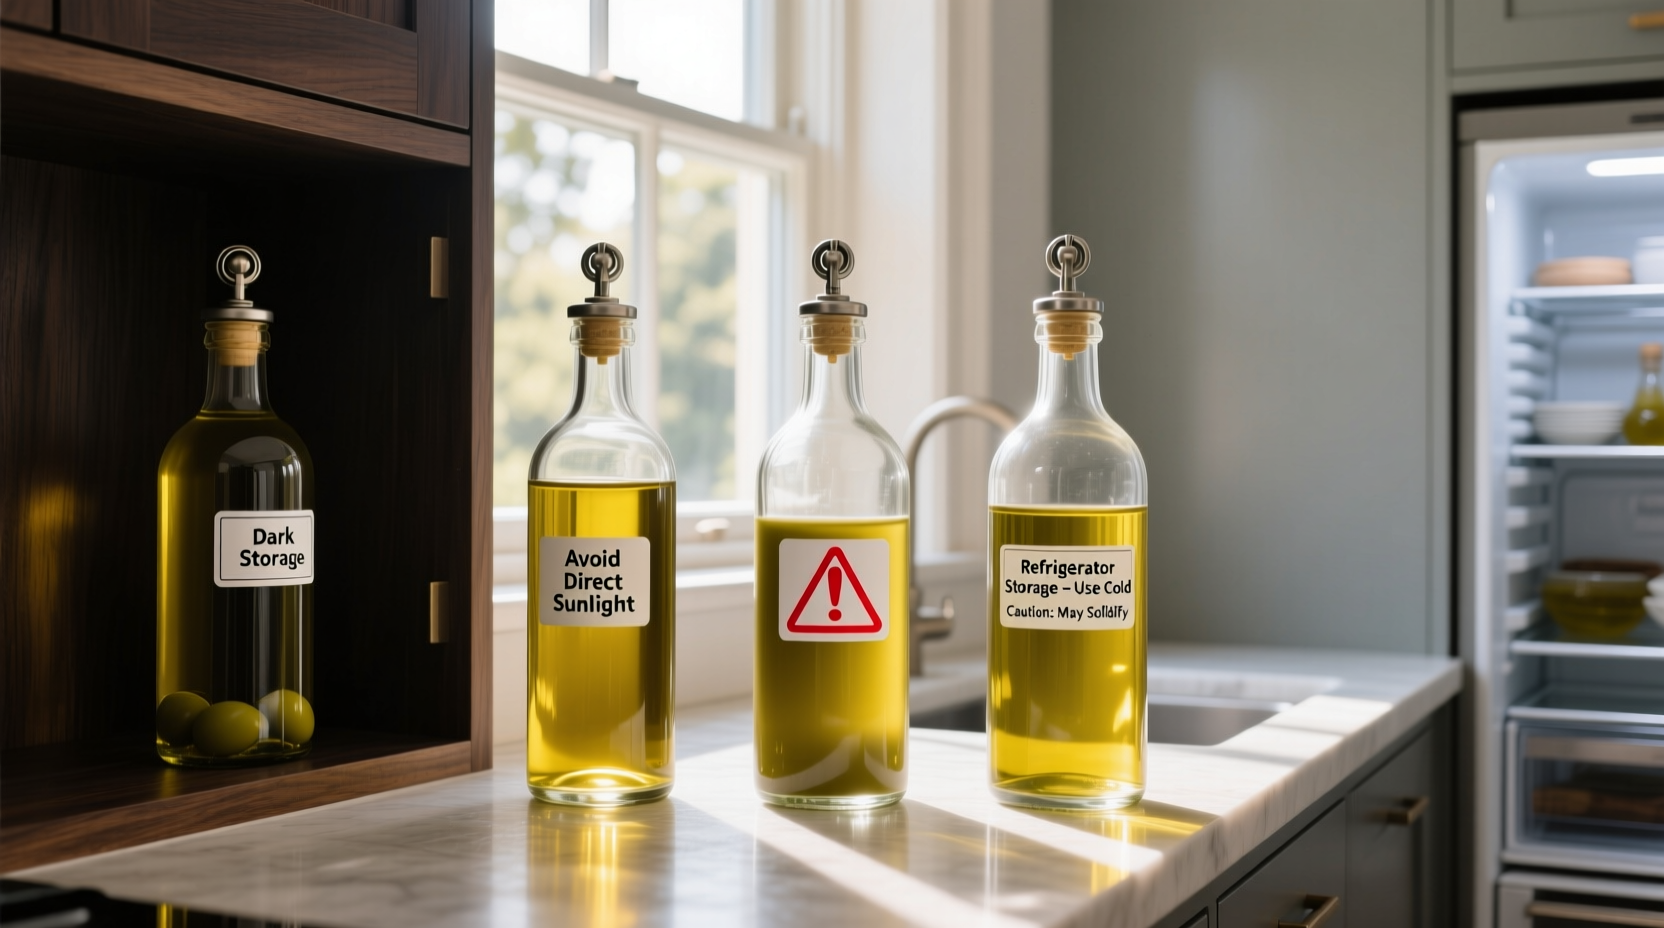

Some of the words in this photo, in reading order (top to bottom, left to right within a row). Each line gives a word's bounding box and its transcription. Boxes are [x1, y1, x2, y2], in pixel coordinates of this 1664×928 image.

[253, 526, 295, 545] Dark
[239, 549, 305, 570] Storage
[564, 549, 621, 568] Avoid
[1021, 559, 1115, 579] Refrigerator
[564, 572, 623, 590] Direct
[1005, 579, 1059, 598] Storage
[1074, 580, 1101, 595] Use
[1103, 579, 1132, 595] Cold
[553, 593, 635, 617] Sunlight
[1057, 606, 1084, 622] May
